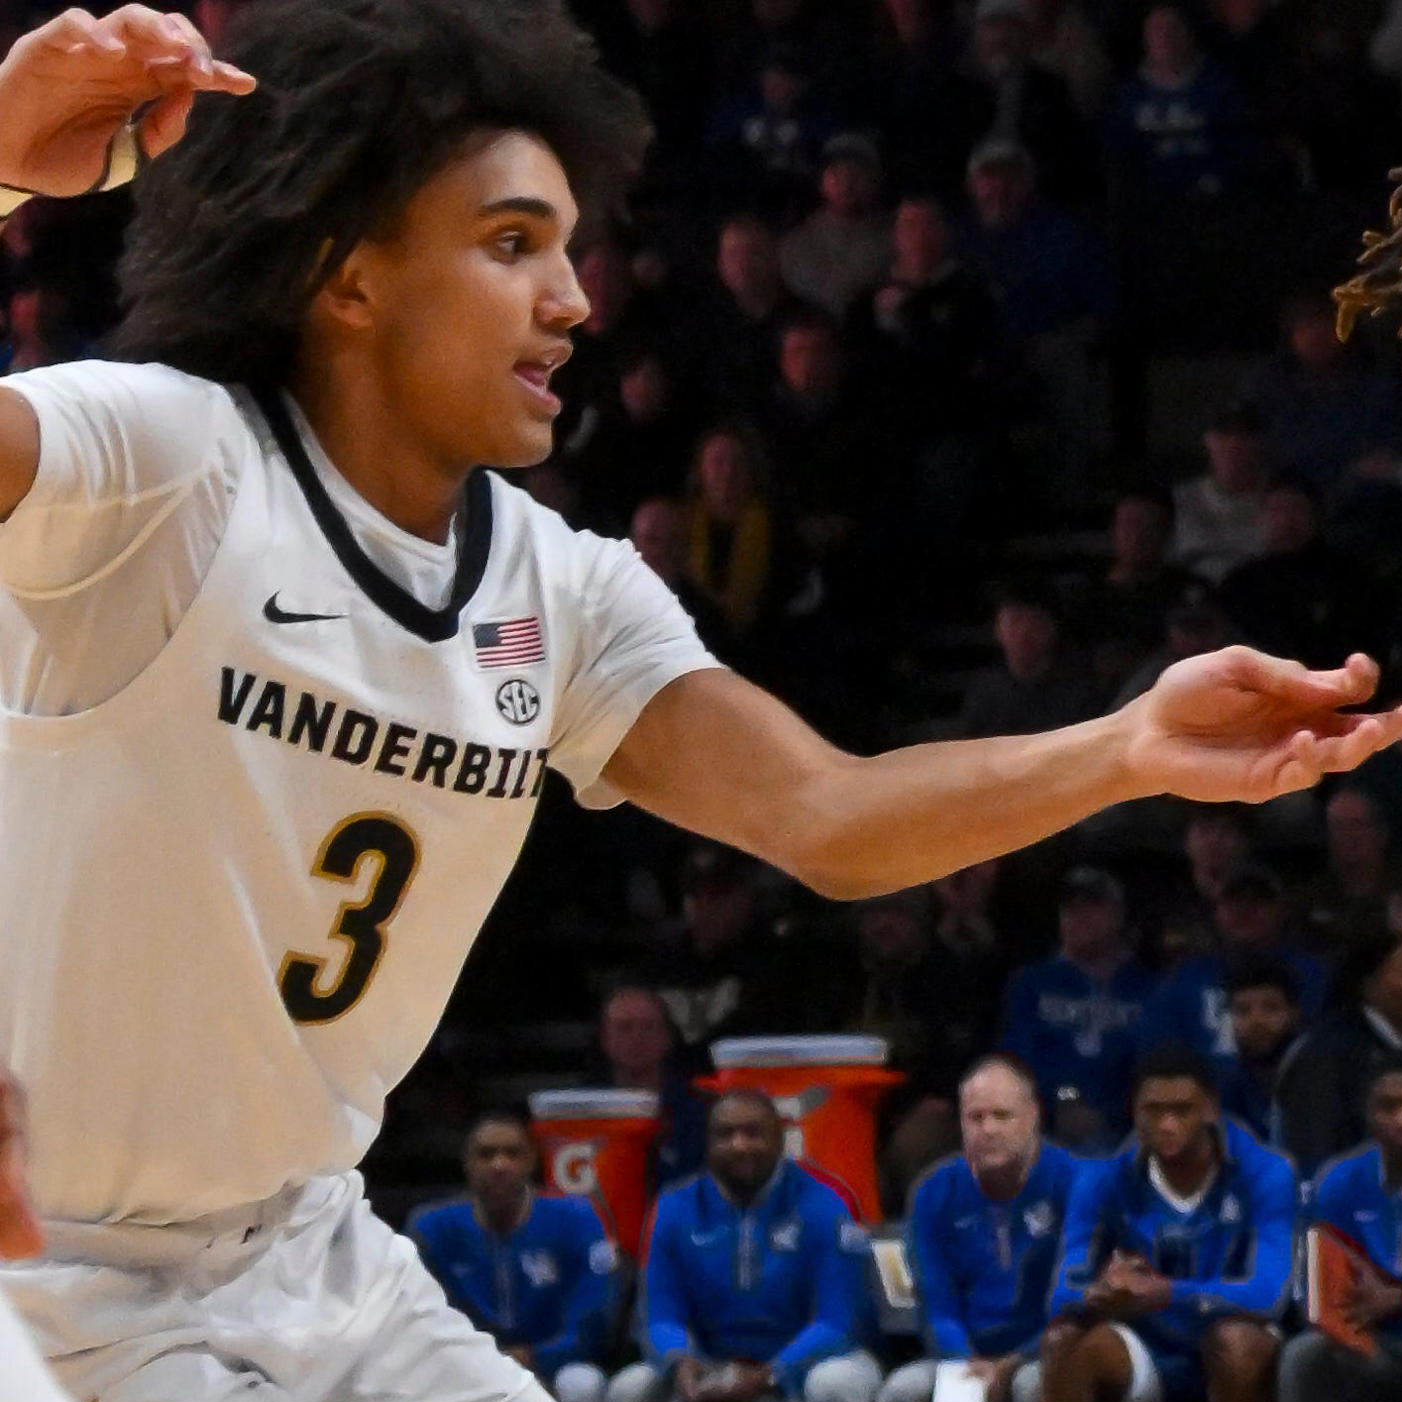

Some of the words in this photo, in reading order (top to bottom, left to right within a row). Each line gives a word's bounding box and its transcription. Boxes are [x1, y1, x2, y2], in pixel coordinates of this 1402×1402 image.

[497, 680, 539, 723] SEC
[277, 809, 422, 1026] 3
[553, 1143, 596, 1195] G
